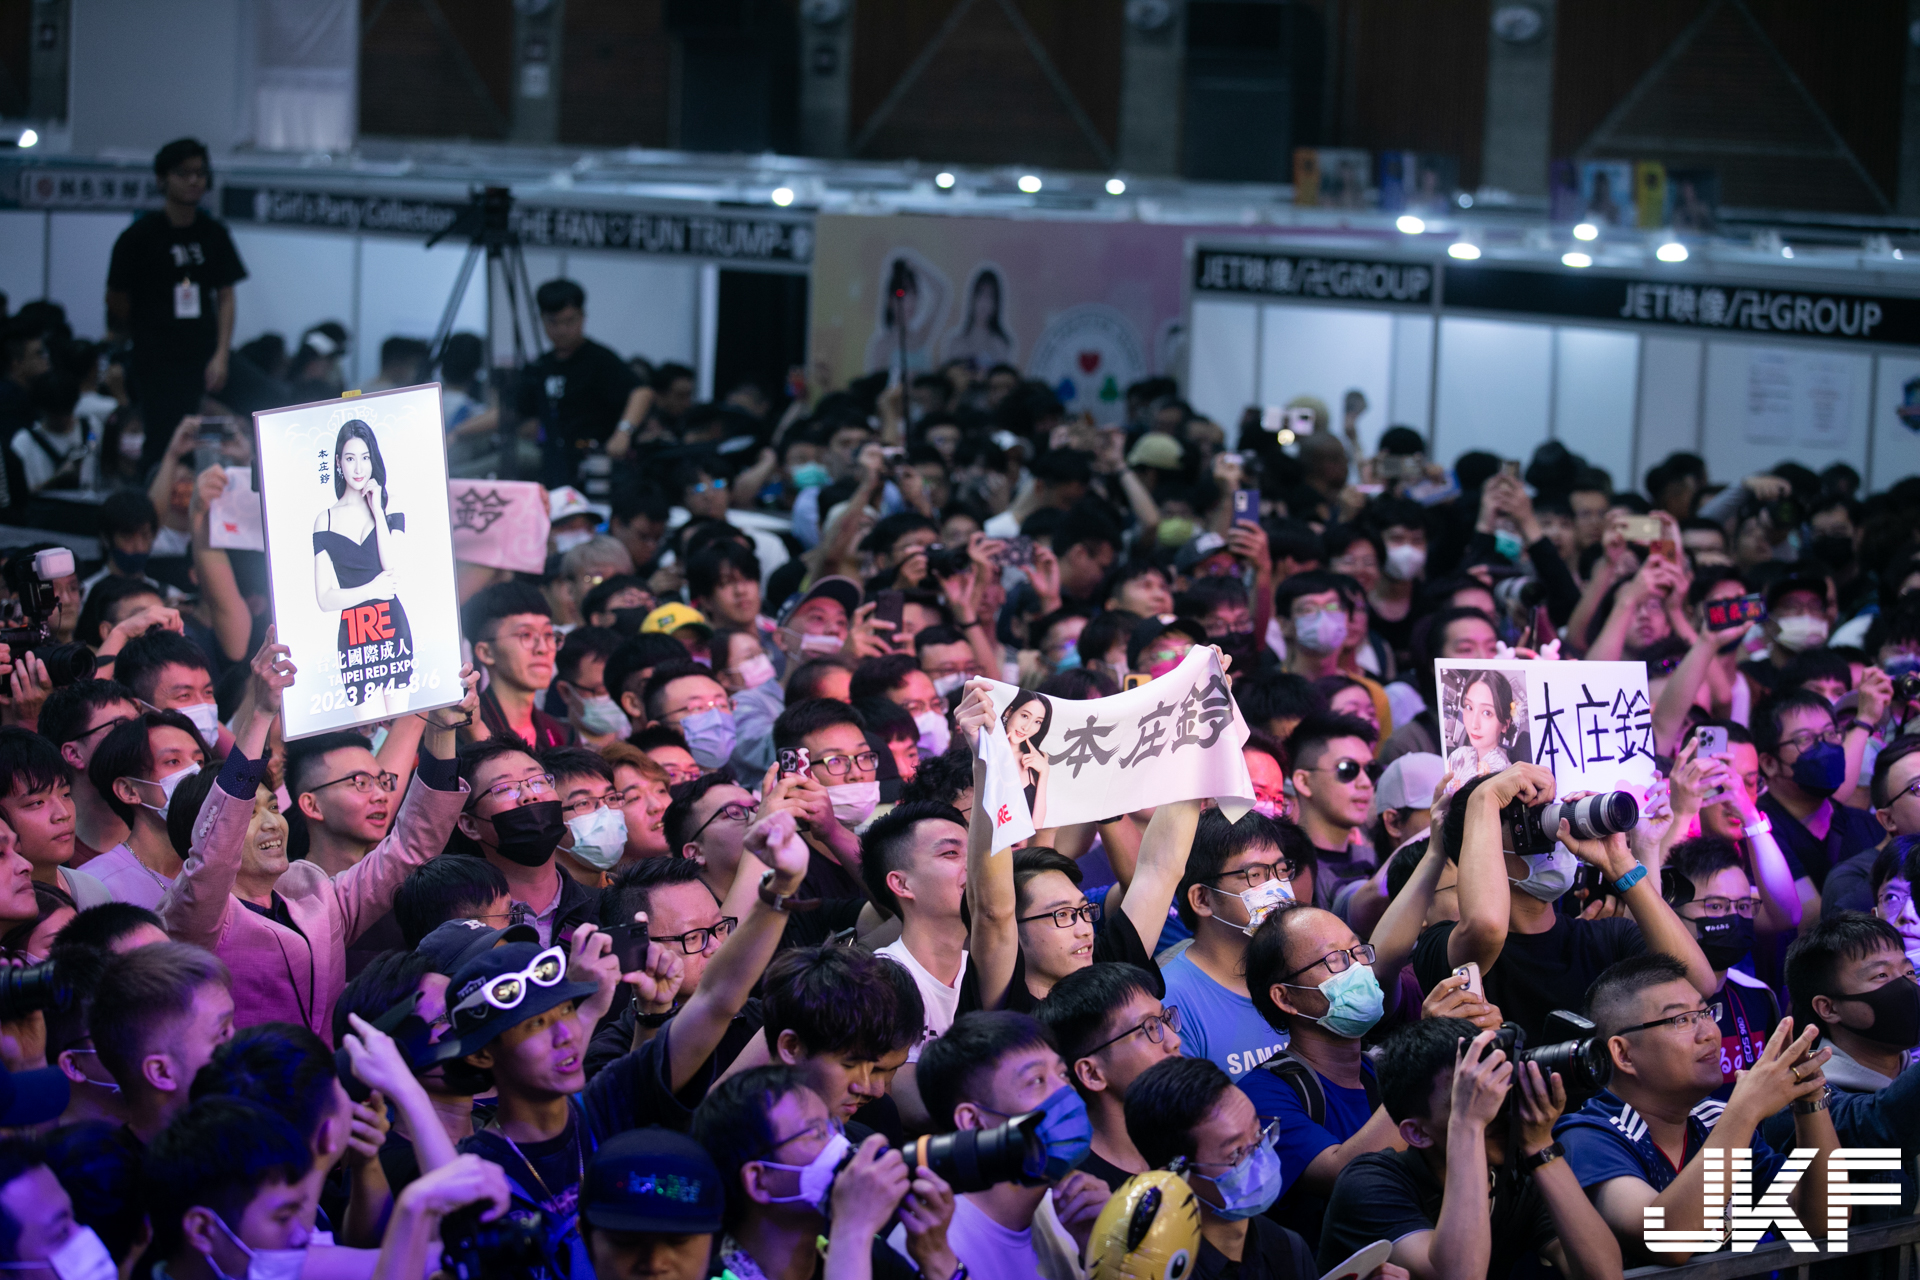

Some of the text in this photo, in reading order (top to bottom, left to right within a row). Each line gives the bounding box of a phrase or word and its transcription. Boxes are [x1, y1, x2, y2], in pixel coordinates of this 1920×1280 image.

[341, 602, 396, 646] TRE
[328, 658, 420, 687] TAIPEI RED EXPO
[310, 686, 358, 716] 2023
[1047, 675, 1234, 779] 本庄鈴
[1534, 682, 1656, 779] 本庄鈴
[1741, 1036, 1754, 1063] EOS
